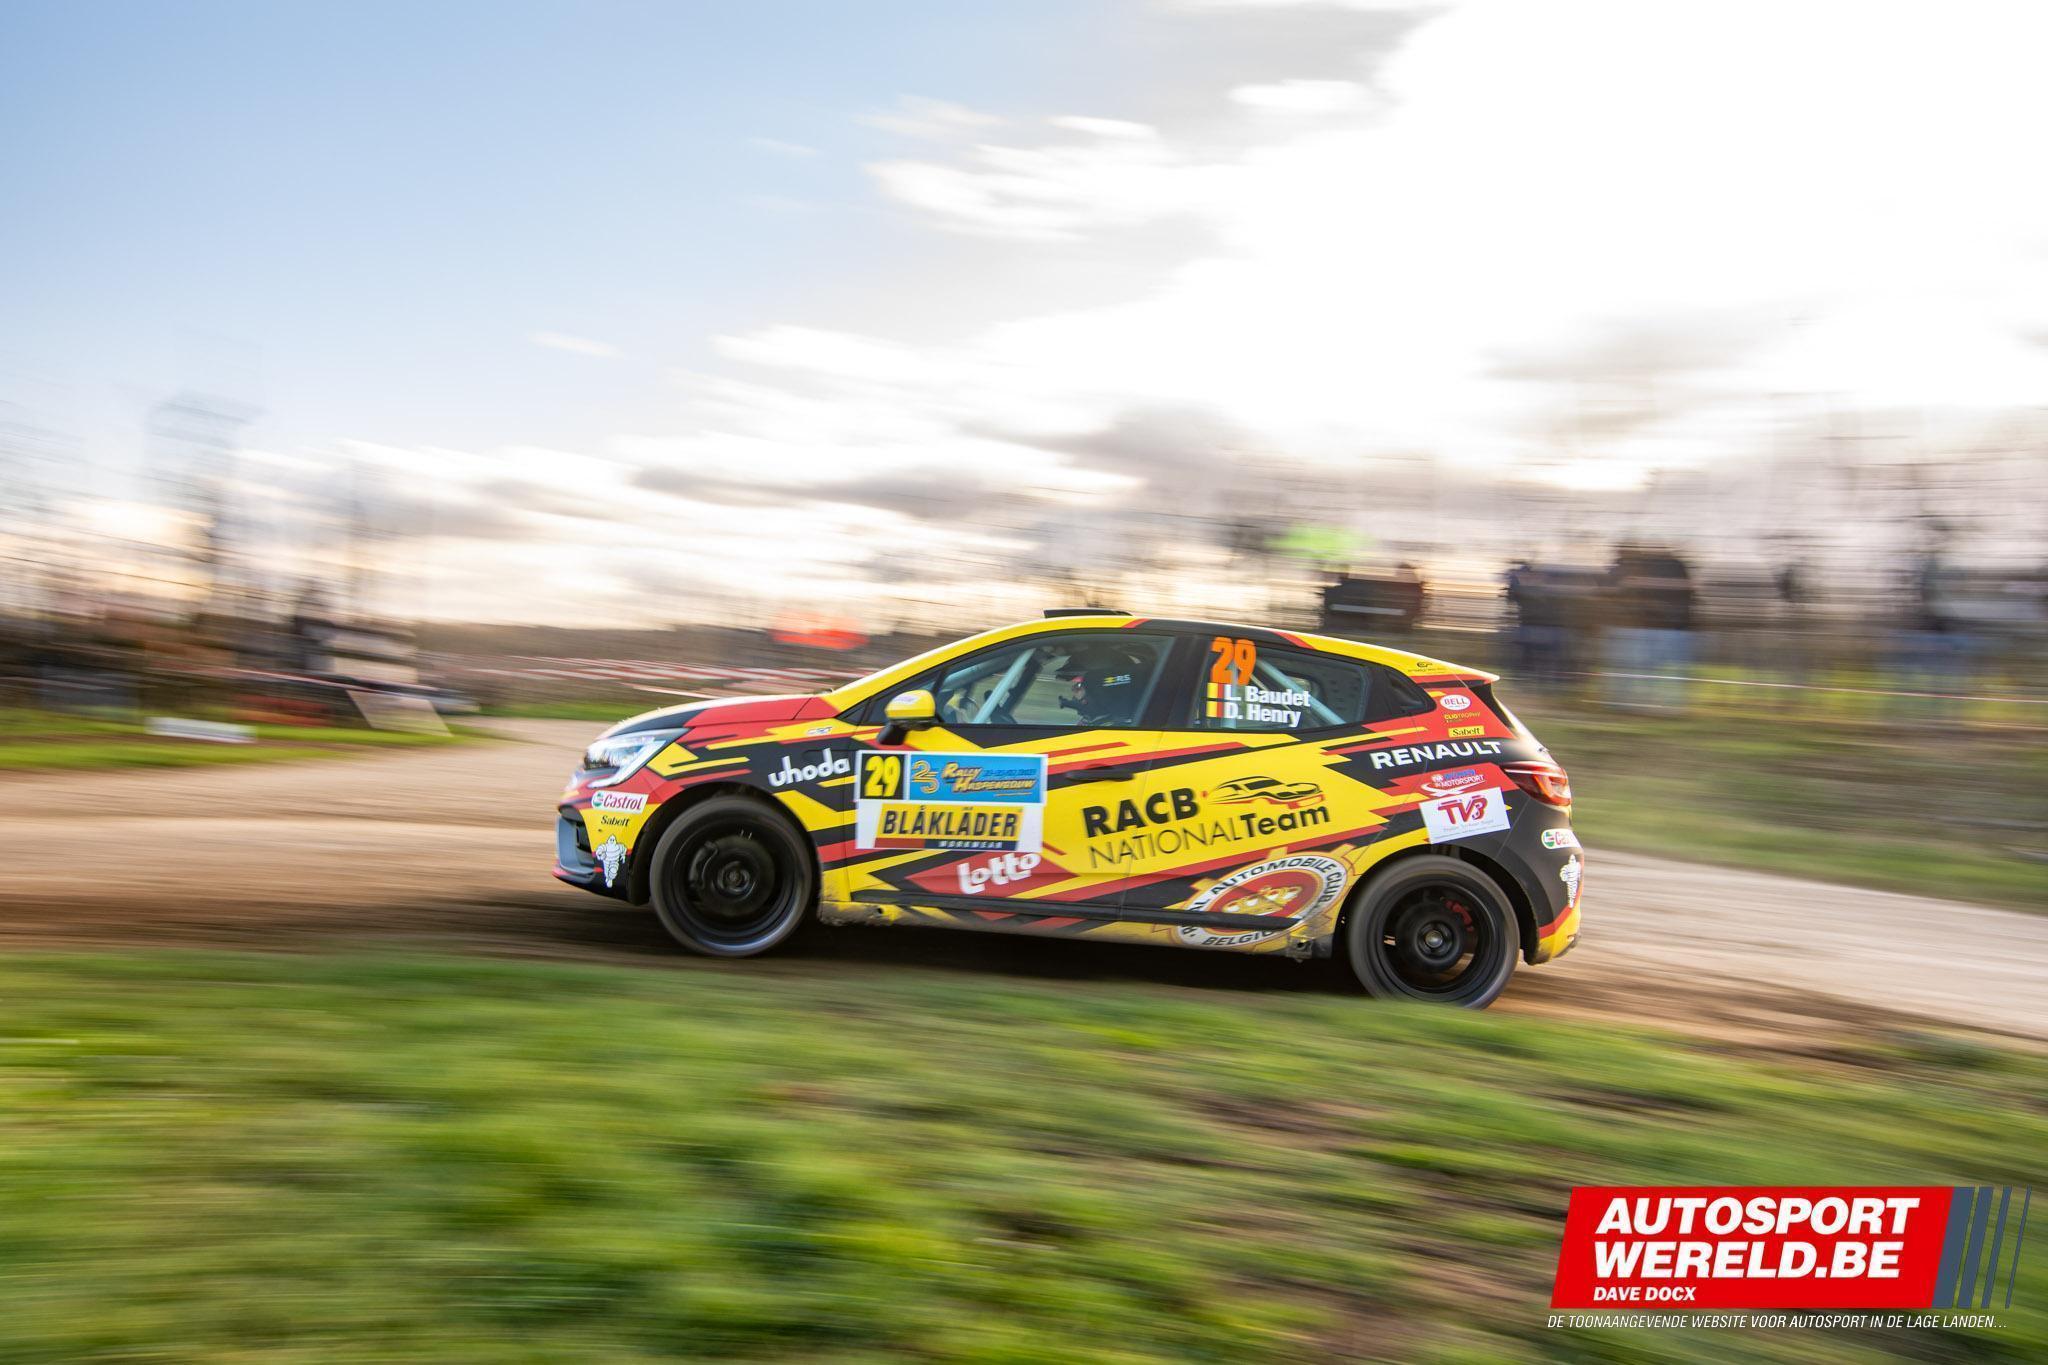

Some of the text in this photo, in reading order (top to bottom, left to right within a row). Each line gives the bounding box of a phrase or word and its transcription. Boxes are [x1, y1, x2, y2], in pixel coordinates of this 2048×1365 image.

[1211, 636, 1257, 686] 29
[1245, 685, 1311, 707] Baudet
[1444, 698, 1468, 706] BELL
[1223, 701, 1302, 728] D. Henry
[768, 747, 851, 787] uhoda
[1369, 741, 1502, 770] RENAULT
[864, 755, 902, 798] 29
[603, 794, 643, 810] Castrol
[1082, 787, 1201, 838] RACB
[882, 804, 1020, 838] BLÅKLÄDER
[957, 852, 1042, 895] Lotto
[1211, 857, 1337, 896] AUTOMOBILE
